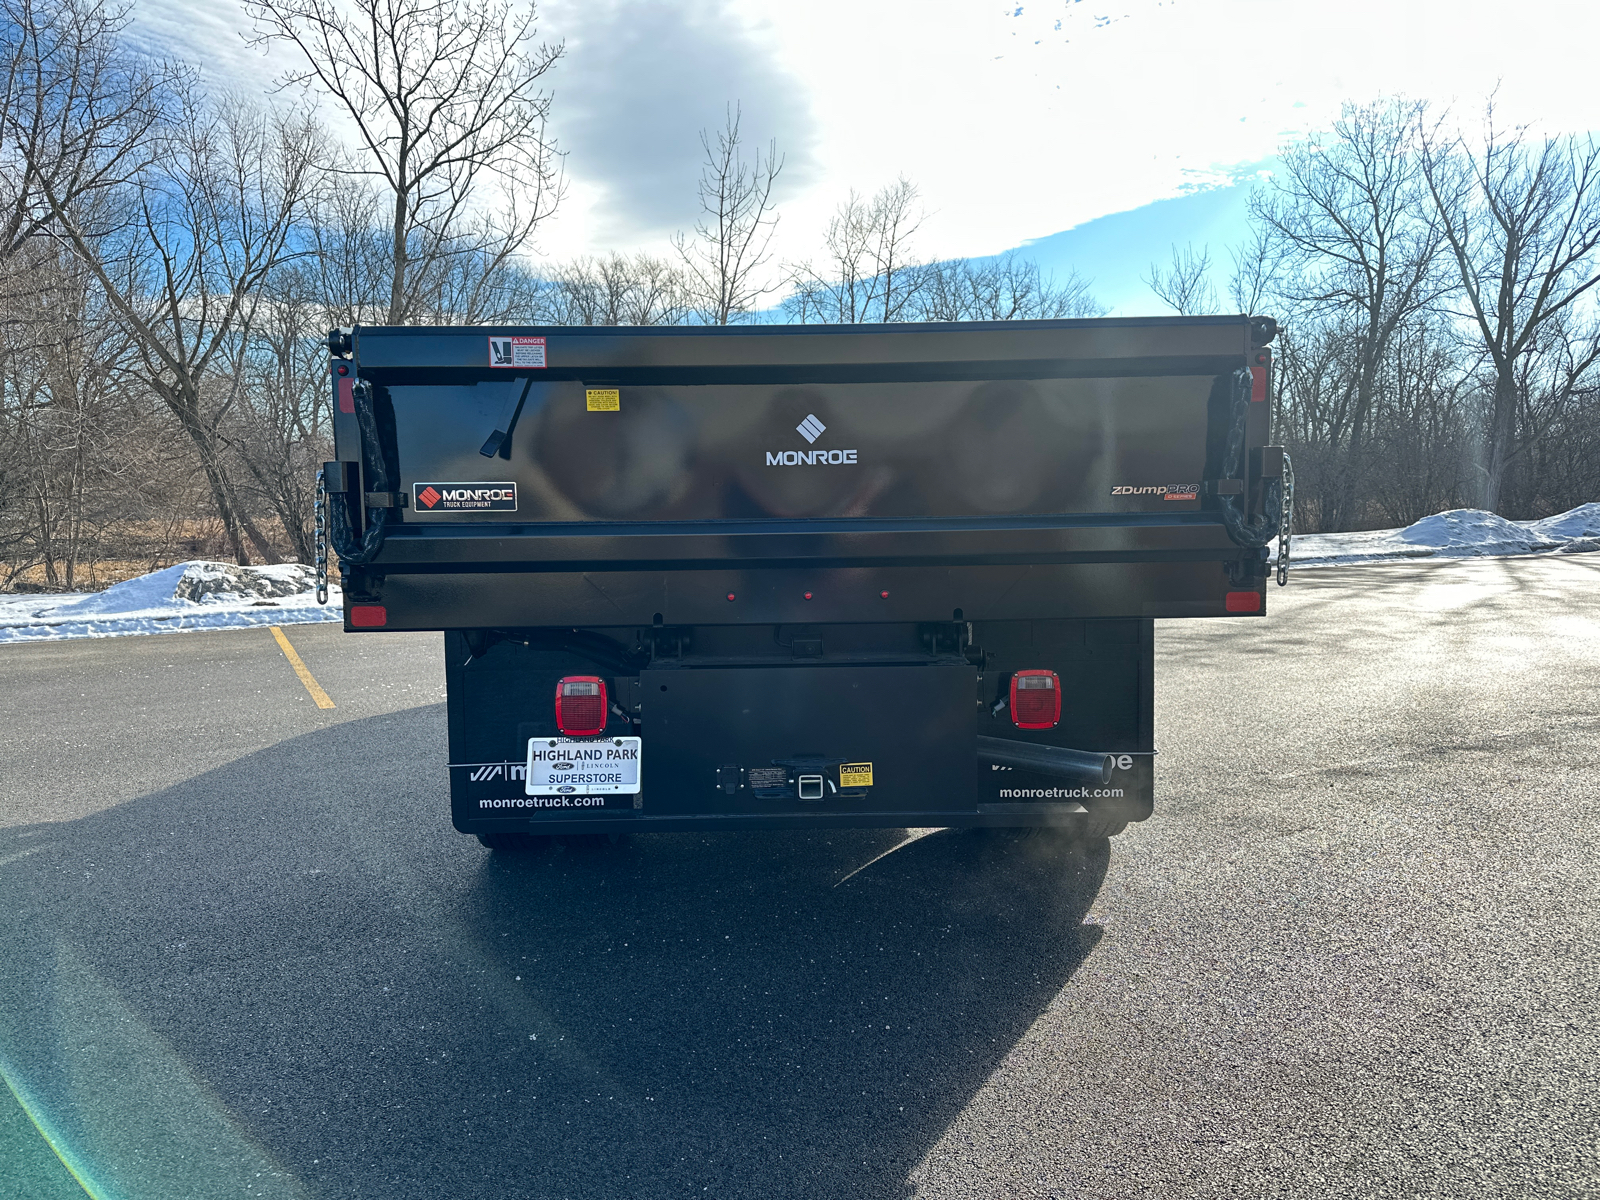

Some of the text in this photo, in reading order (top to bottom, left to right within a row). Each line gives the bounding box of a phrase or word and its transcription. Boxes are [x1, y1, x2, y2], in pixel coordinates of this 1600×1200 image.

[765, 449, 858, 466] MONROE
[442, 489, 513, 501] MONROE
[533, 749, 638, 762] HIGHLAND PARK
[842, 766, 870, 774] CAUTION
[548, 773, 622, 783] SUPERSTORE
[999, 786, 1124, 798] monroetruck.com
[479, 795, 605, 808] monroetruck.com
